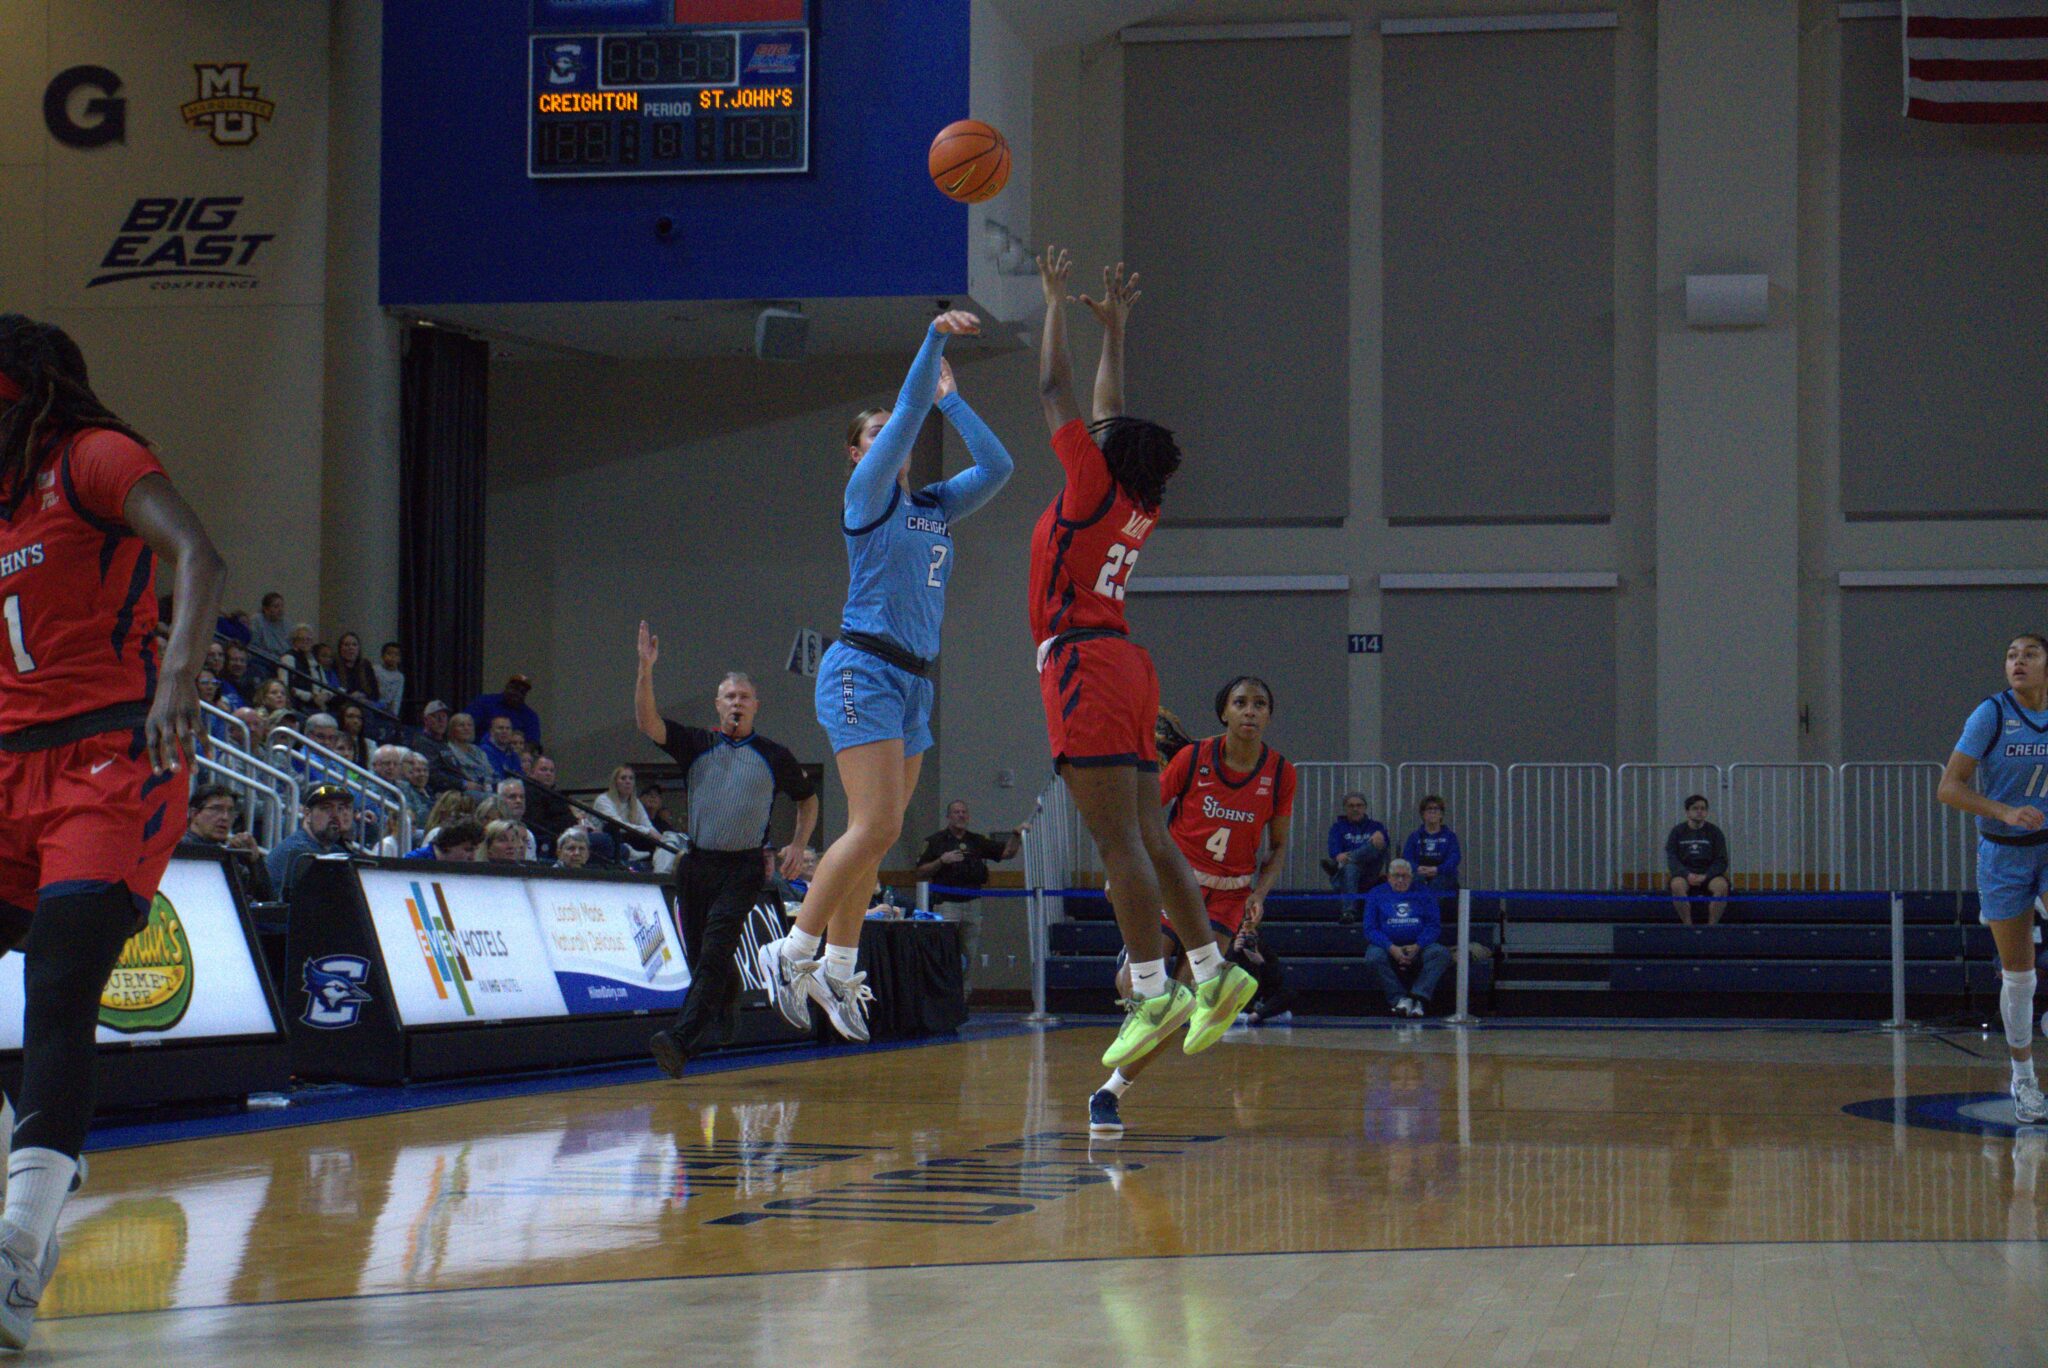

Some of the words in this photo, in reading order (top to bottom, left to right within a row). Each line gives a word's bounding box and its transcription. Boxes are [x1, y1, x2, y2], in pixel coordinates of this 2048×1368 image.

[43, 65, 127, 148] G
[539, 92, 638, 112] CREIGHTON
[643, 102, 691, 117] PERIOD
[120, 197, 244, 232] BIG
[101, 234, 276, 267] EAST
[151, 281, 259, 290] CONFERENCE
[906, 516, 951, 537] CREIGH
[927, 545, 948, 588] 2
[3, 594, 37, 674] 1
[1351, 636, 1380, 652] 114
[842, 670, 858, 725] BLUEJAYS
[1205, 807, 1255, 823] JOHN'S
[1205, 826, 1232, 862] 4
[416, 929, 466, 957] EVEN
[460, 930, 509, 956] HOTELS
[102, 972, 174, 992] URMET
[111, 990, 153, 1006] CAFE
